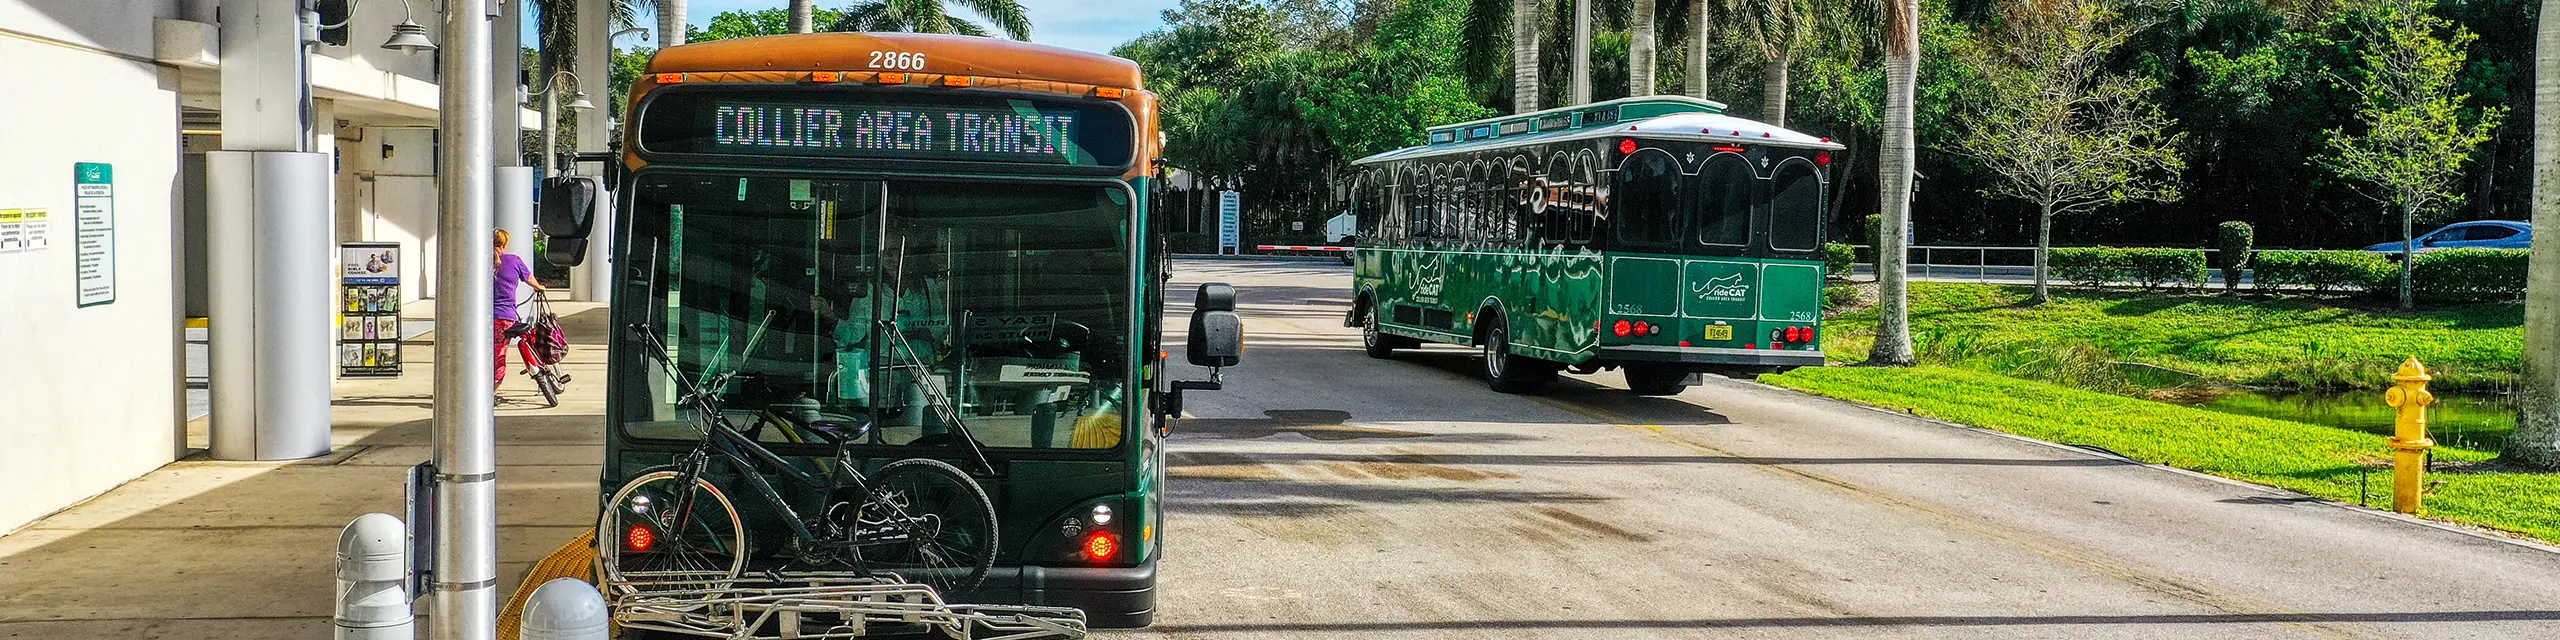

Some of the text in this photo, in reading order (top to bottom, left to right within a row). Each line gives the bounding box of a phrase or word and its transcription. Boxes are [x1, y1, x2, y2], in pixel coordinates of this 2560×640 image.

[868, 51, 925, 70] 2866
[717, 107, 1072, 154] COLLIER AREA TRANSIT
[1617, 304, 1643, 314] 2568
[1790, 311, 1811, 321] 2568
